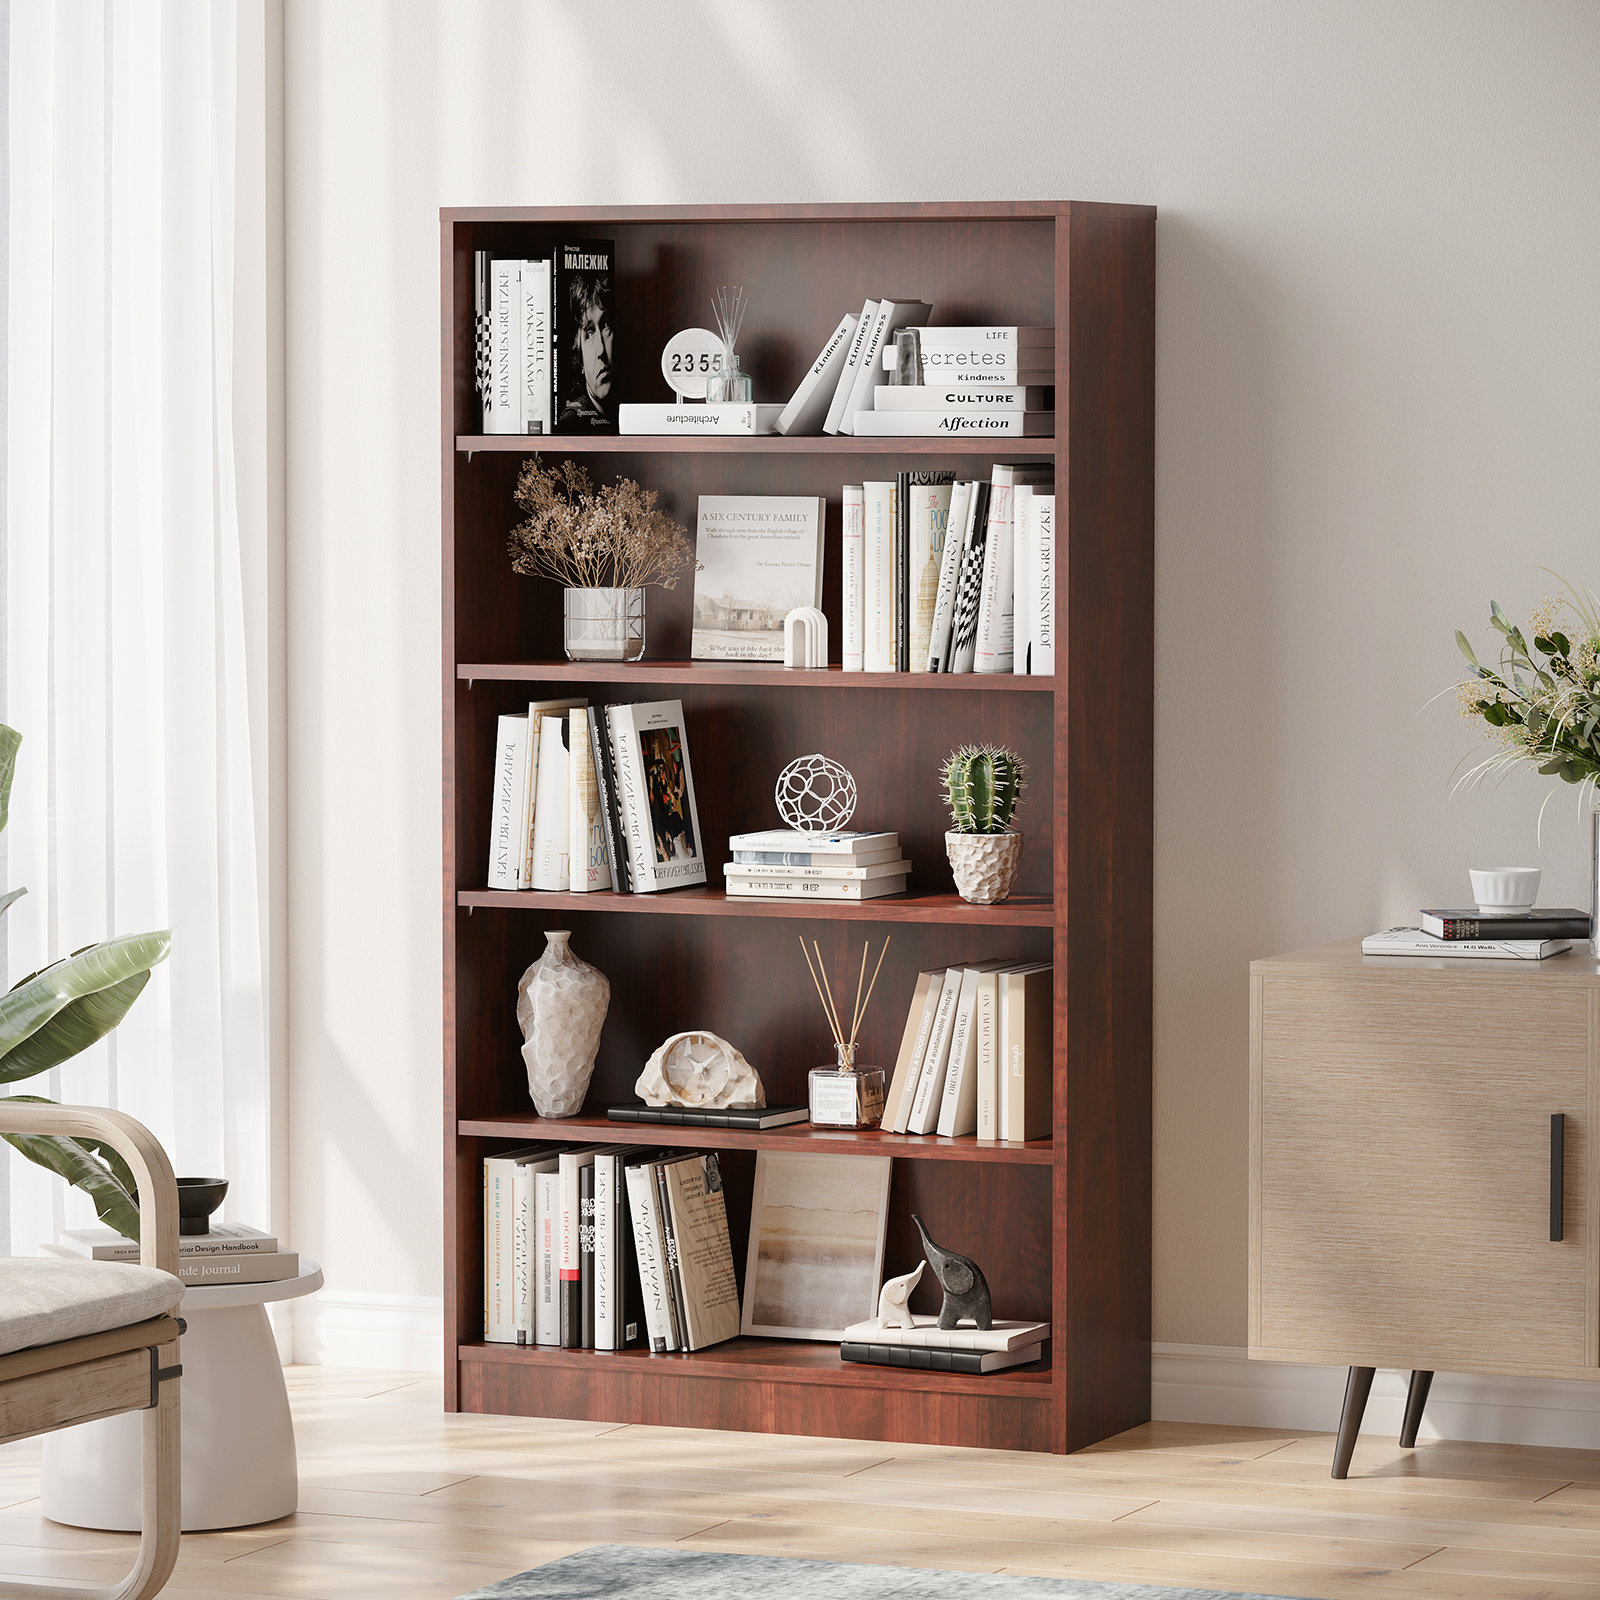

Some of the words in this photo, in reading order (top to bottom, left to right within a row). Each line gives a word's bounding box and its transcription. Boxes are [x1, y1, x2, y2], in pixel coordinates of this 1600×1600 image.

[564, 253, 609, 271] МАЛЕЖИК
[849, 313, 871, 367] Kindness
[864, 313, 887, 367] Kindness
[986, 331, 1009, 340] LIFE
[814, 327, 847, 375] Kindness
[671, 353, 694, 372] 23
[499, 336, 510, 409] JOHANNES
[945, 393, 1014, 403] CULTURE
[666, 415, 720, 425] Architecture
[939, 416, 1010, 432] Affection
[925, 494, 939, 510] The
[709, 512, 725, 521] SIX
[726, 513, 771, 522] CENTURY
[773, 514, 809, 522] FAMILY
[1040, 506, 1051, 573] GRÜTZKE
[1040, 574, 1051, 648] JOHANNES
[983, 994, 990, 1008] ON
[914, 1036, 925, 1059] GOOD
[920, 1010, 932, 1035] GUIDE
[926, 1063, 935, 1076] for
[932, 1017, 946, 1057] sustainable
[942, 988, 954, 1017] lifestyle
[948, 1066, 960, 1096] DREAM
[958, 1011, 969, 1039] AWAKE
[195, 1245, 220, 1253] Design
[221, 1242, 260, 1251] Handbook
[201, 1263, 241, 1277] Journal
